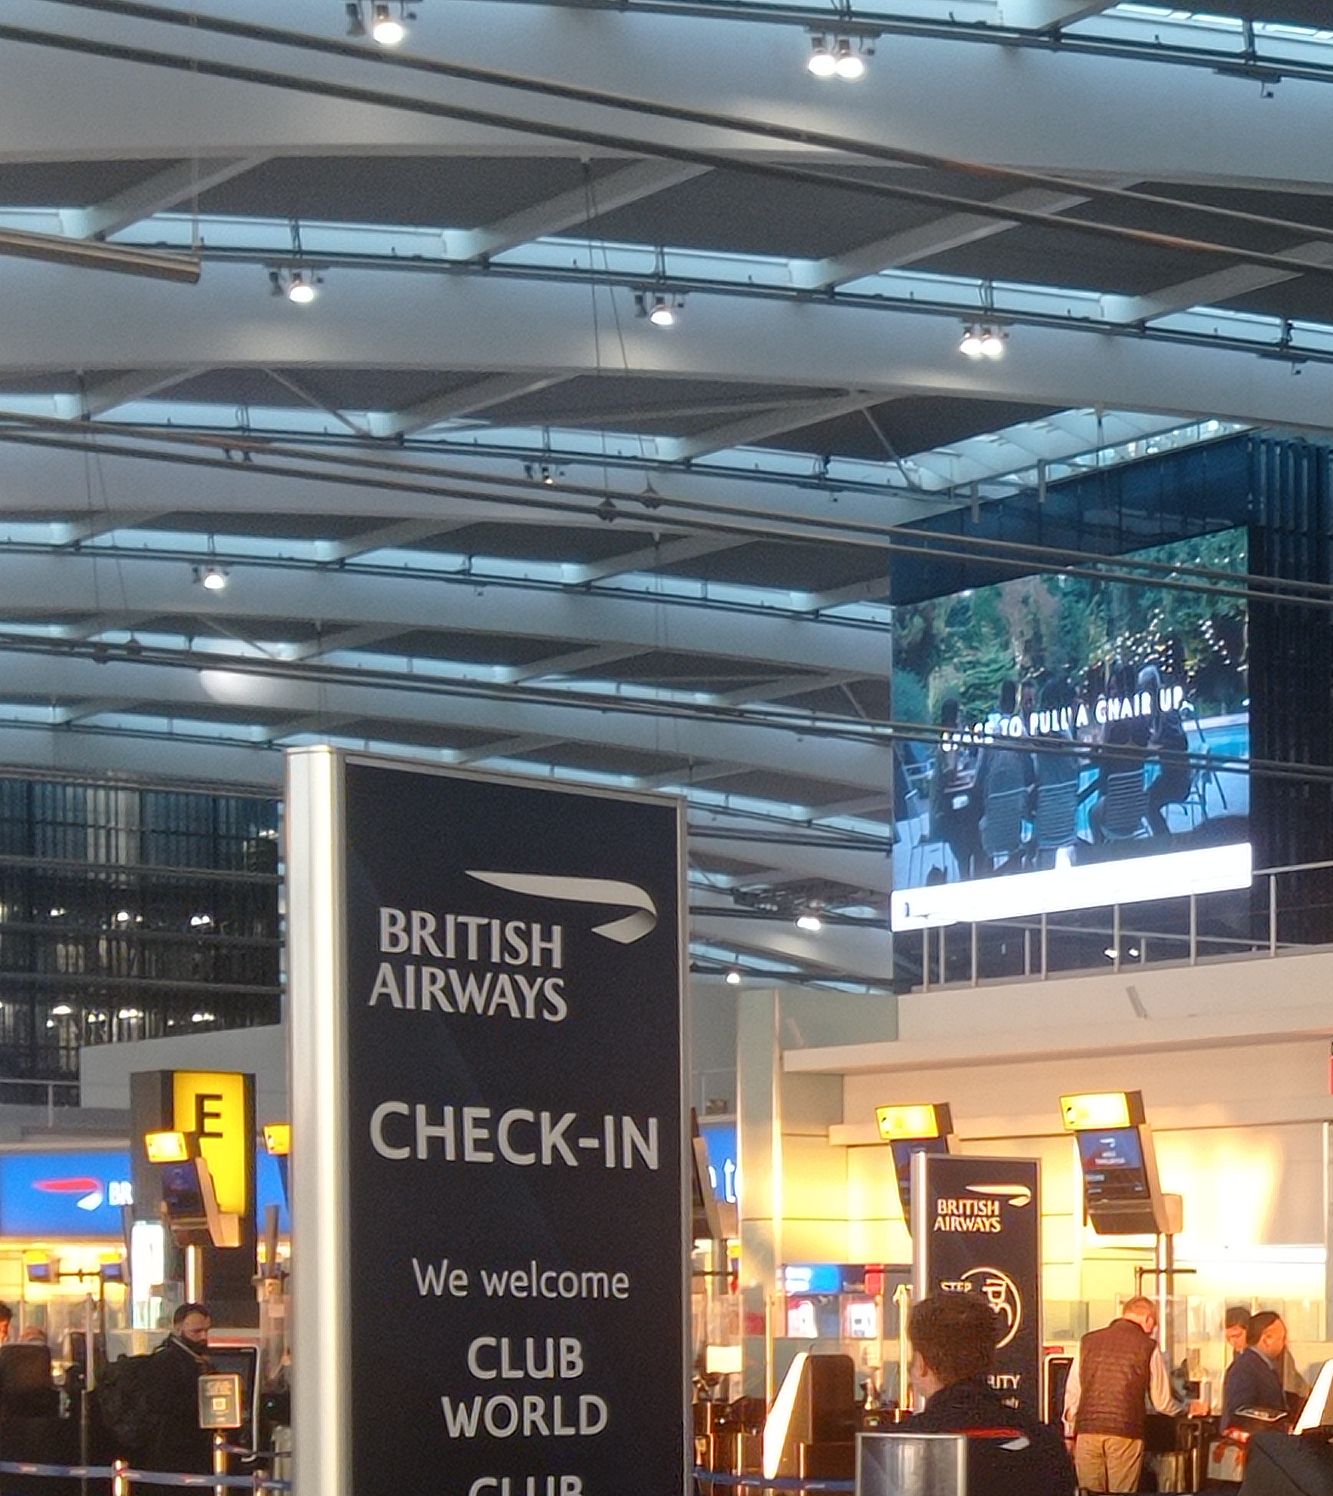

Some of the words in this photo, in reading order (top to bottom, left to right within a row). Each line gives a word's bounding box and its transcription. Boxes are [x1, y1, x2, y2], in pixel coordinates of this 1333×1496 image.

[1002, 716, 1022, 737] TO
[1076, 704, 1088, 727] A
[378, 906, 564, 969] BRITISH
[368, 962, 568, 1022] AIRWAYS
[194, 1093, 223, 1138] E
[369, 1099, 659, 1170] CHECK-IN
[934, 1217, 1001, 1232] AIRWAYS
[937, 1199, 1000, 1216] BRITISH
[412, 1257, 469, 1297] We
[480, 1260, 630, 1299] welcome
[467, 1336, 584, 1380] CLUB
[440, 1394, 609, 1438] WORLD
